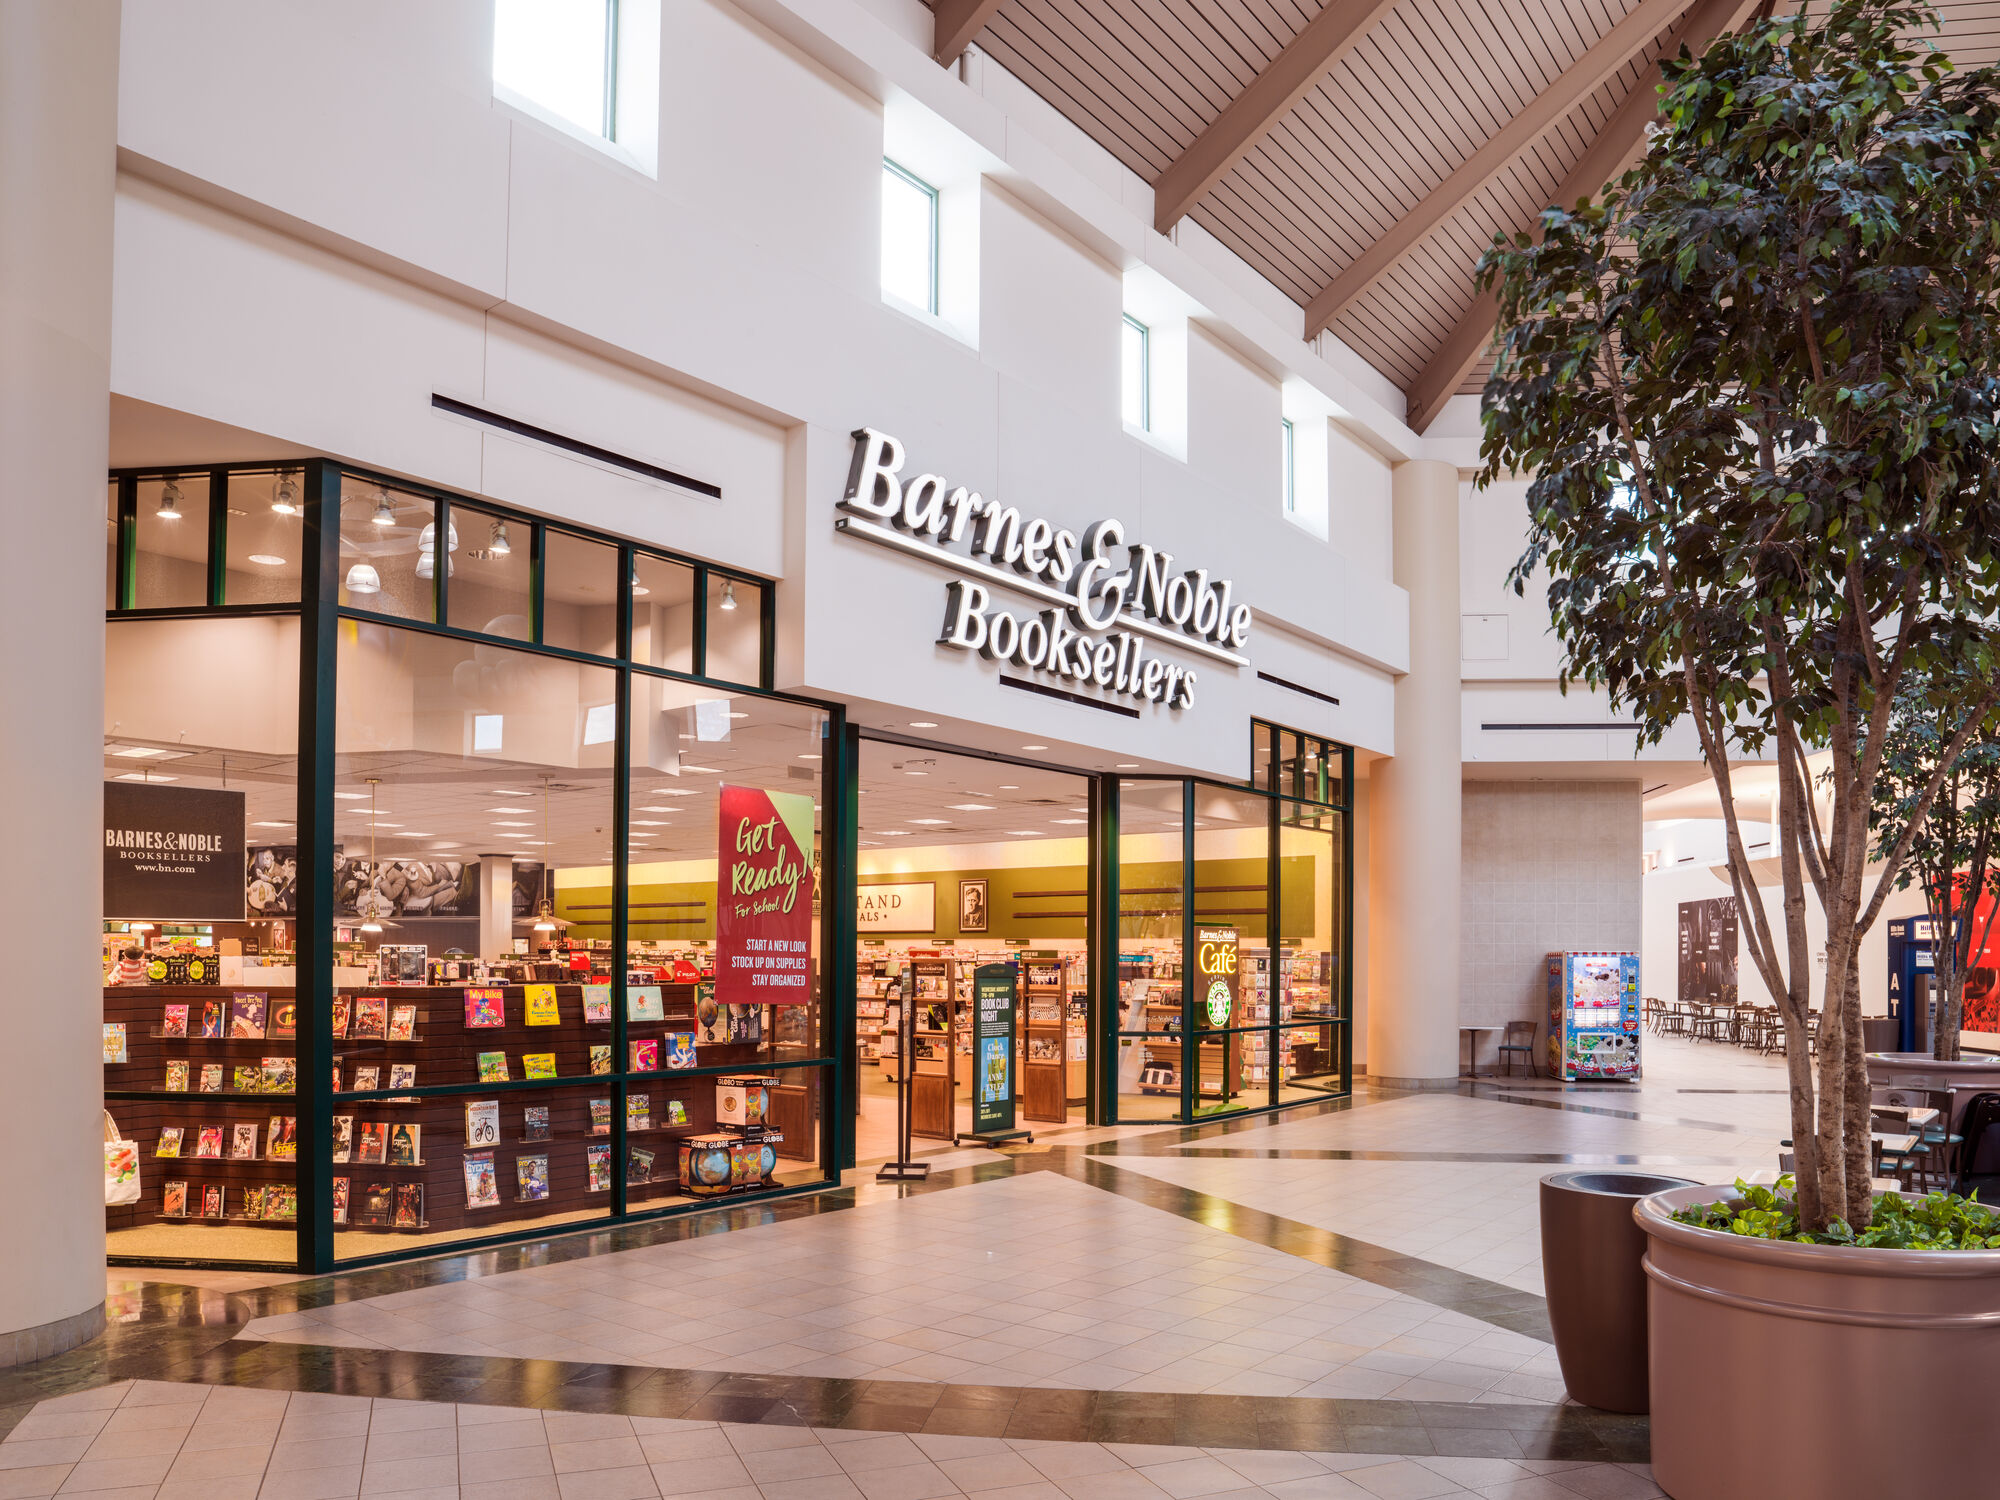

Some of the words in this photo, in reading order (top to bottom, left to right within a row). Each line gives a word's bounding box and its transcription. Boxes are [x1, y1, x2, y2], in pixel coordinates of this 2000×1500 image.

[837, 427, 1077, 583] Barnes
[1067, 518, 1133, 631] &
[1129, 544, 1252, 649] Noble
[938, 579, 1198, 712] Booksellers
[736, 816, 782, 856] Get
[120, 851, 211, 862] BOOKSELLERS
[135, 863, 196, 873] www.bn.com
[732, 844, 810, 914] Ready!
[735, 904, 751, 919] For
[753, 896, 780, 916] School
[746, 939, 767, 951] START
[768, 939, 773, 951] A
[774, 940, 789, 952] NEW
[789, 940, 807, 953] LOOK
[731, 956, 754, 968] STOCK
[755, 957, 764, 968] UP
[765, 957, 775, 969] ON
[776, 957, 806, 970] SUPPLIES
[1200, 942, 1237, 974] Café
[752, 974, 769, 986] STAY
[769, 975, 806, 987] ORGANIZED
[470, 990, 483, 999] My
[485, 990, 502, 999] Bike
[981, 998, 996, 1010] BOOK
[996, 997, 1010, 1010] CLUB
[981, 1010, 998, 1022] NIGHT
[691, 1141, 707, 1149] GLOBE
[708, 1141, 729, 1149] GLOBE
[763, 1135, 784, 1143] GLOBE
